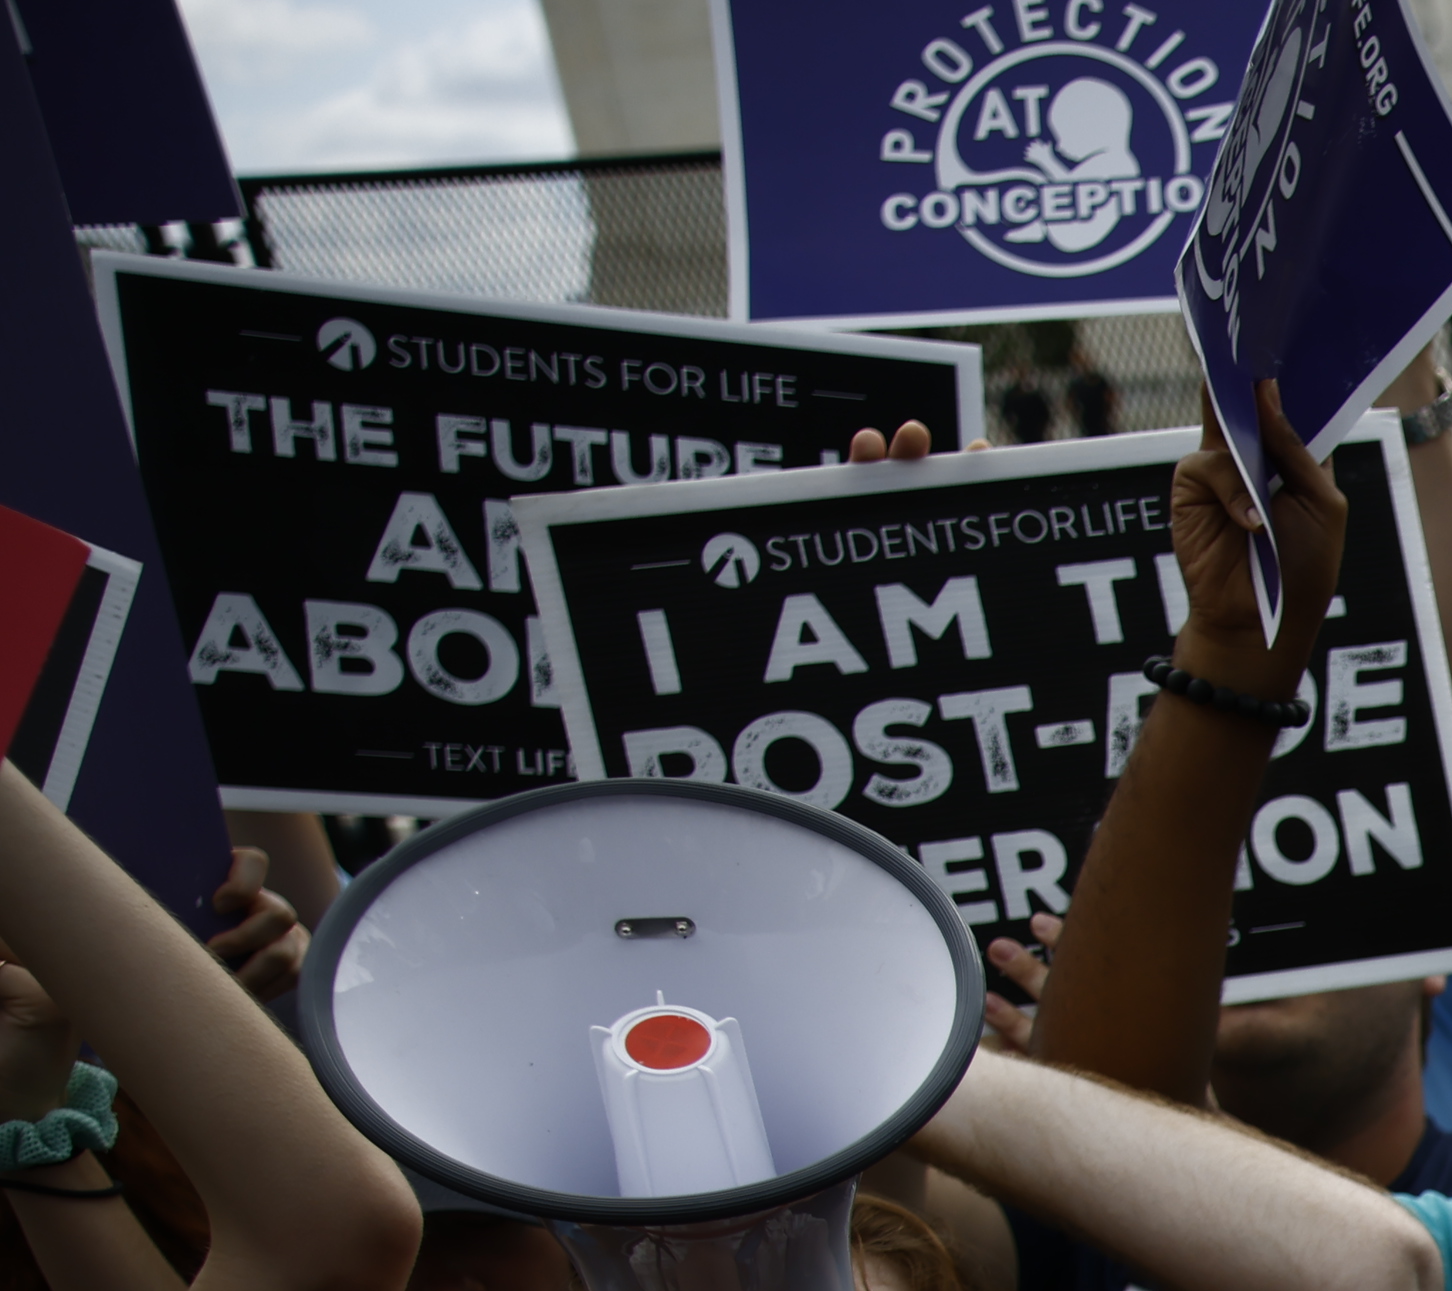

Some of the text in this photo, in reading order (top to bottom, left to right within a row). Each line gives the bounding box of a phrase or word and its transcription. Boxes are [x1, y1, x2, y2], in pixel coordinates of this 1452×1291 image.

[880, 0, 1234, 163] PROTECTION
[973, 84, 1050, 141] AT
[386, 333, 799, 409] STUDENTS FOR LIFE
[205, 388, 400, 468] THE
[636, 607, 684, 697] I
[762, 573, 994, 685] AM
[421, 741, 506, 774] TEXT
